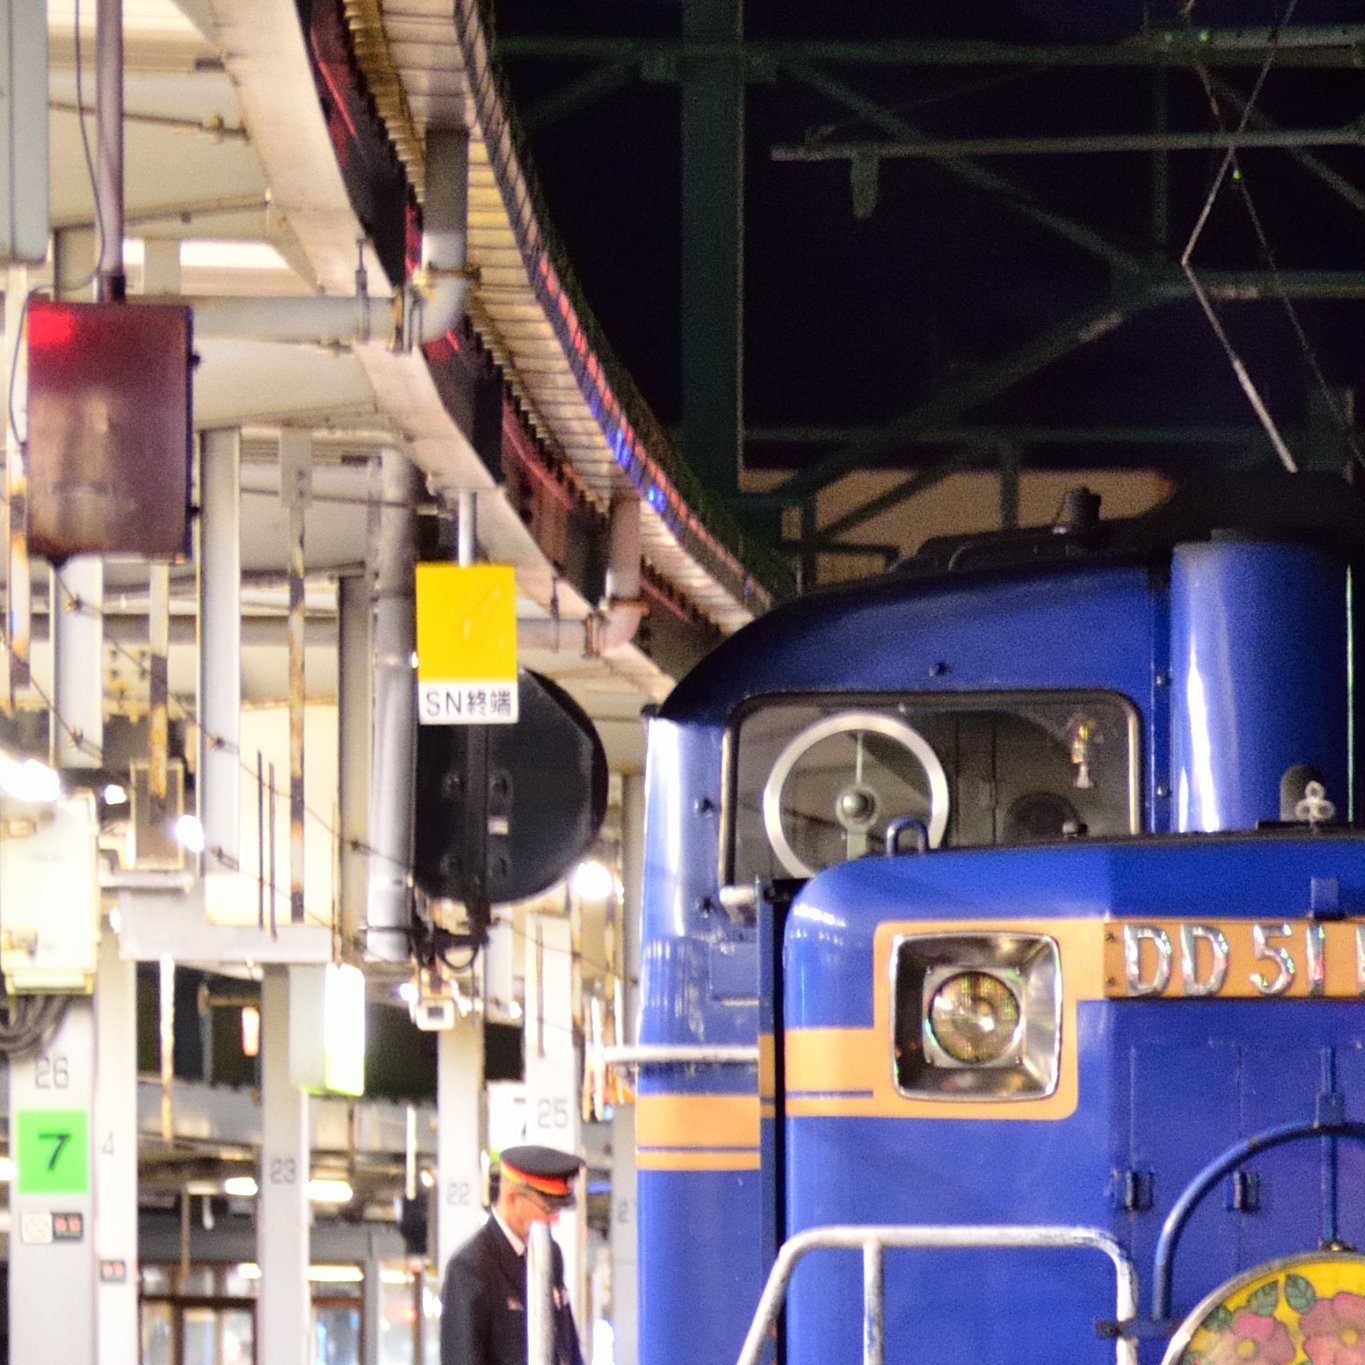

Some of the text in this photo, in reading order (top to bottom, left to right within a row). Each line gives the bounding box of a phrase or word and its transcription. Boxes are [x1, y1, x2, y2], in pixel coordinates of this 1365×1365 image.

[425, 690, 511, 717] SN終端
[1123, 922, 1230, 998] DD
[1249, 922, 1327, 997] 51
[34, 1056, 70, 1090] 26
[537, 1098, 568, 1129] 25
[37, 1132, 73, 1173] 7
[270, 1157, 297, 1185] 23
